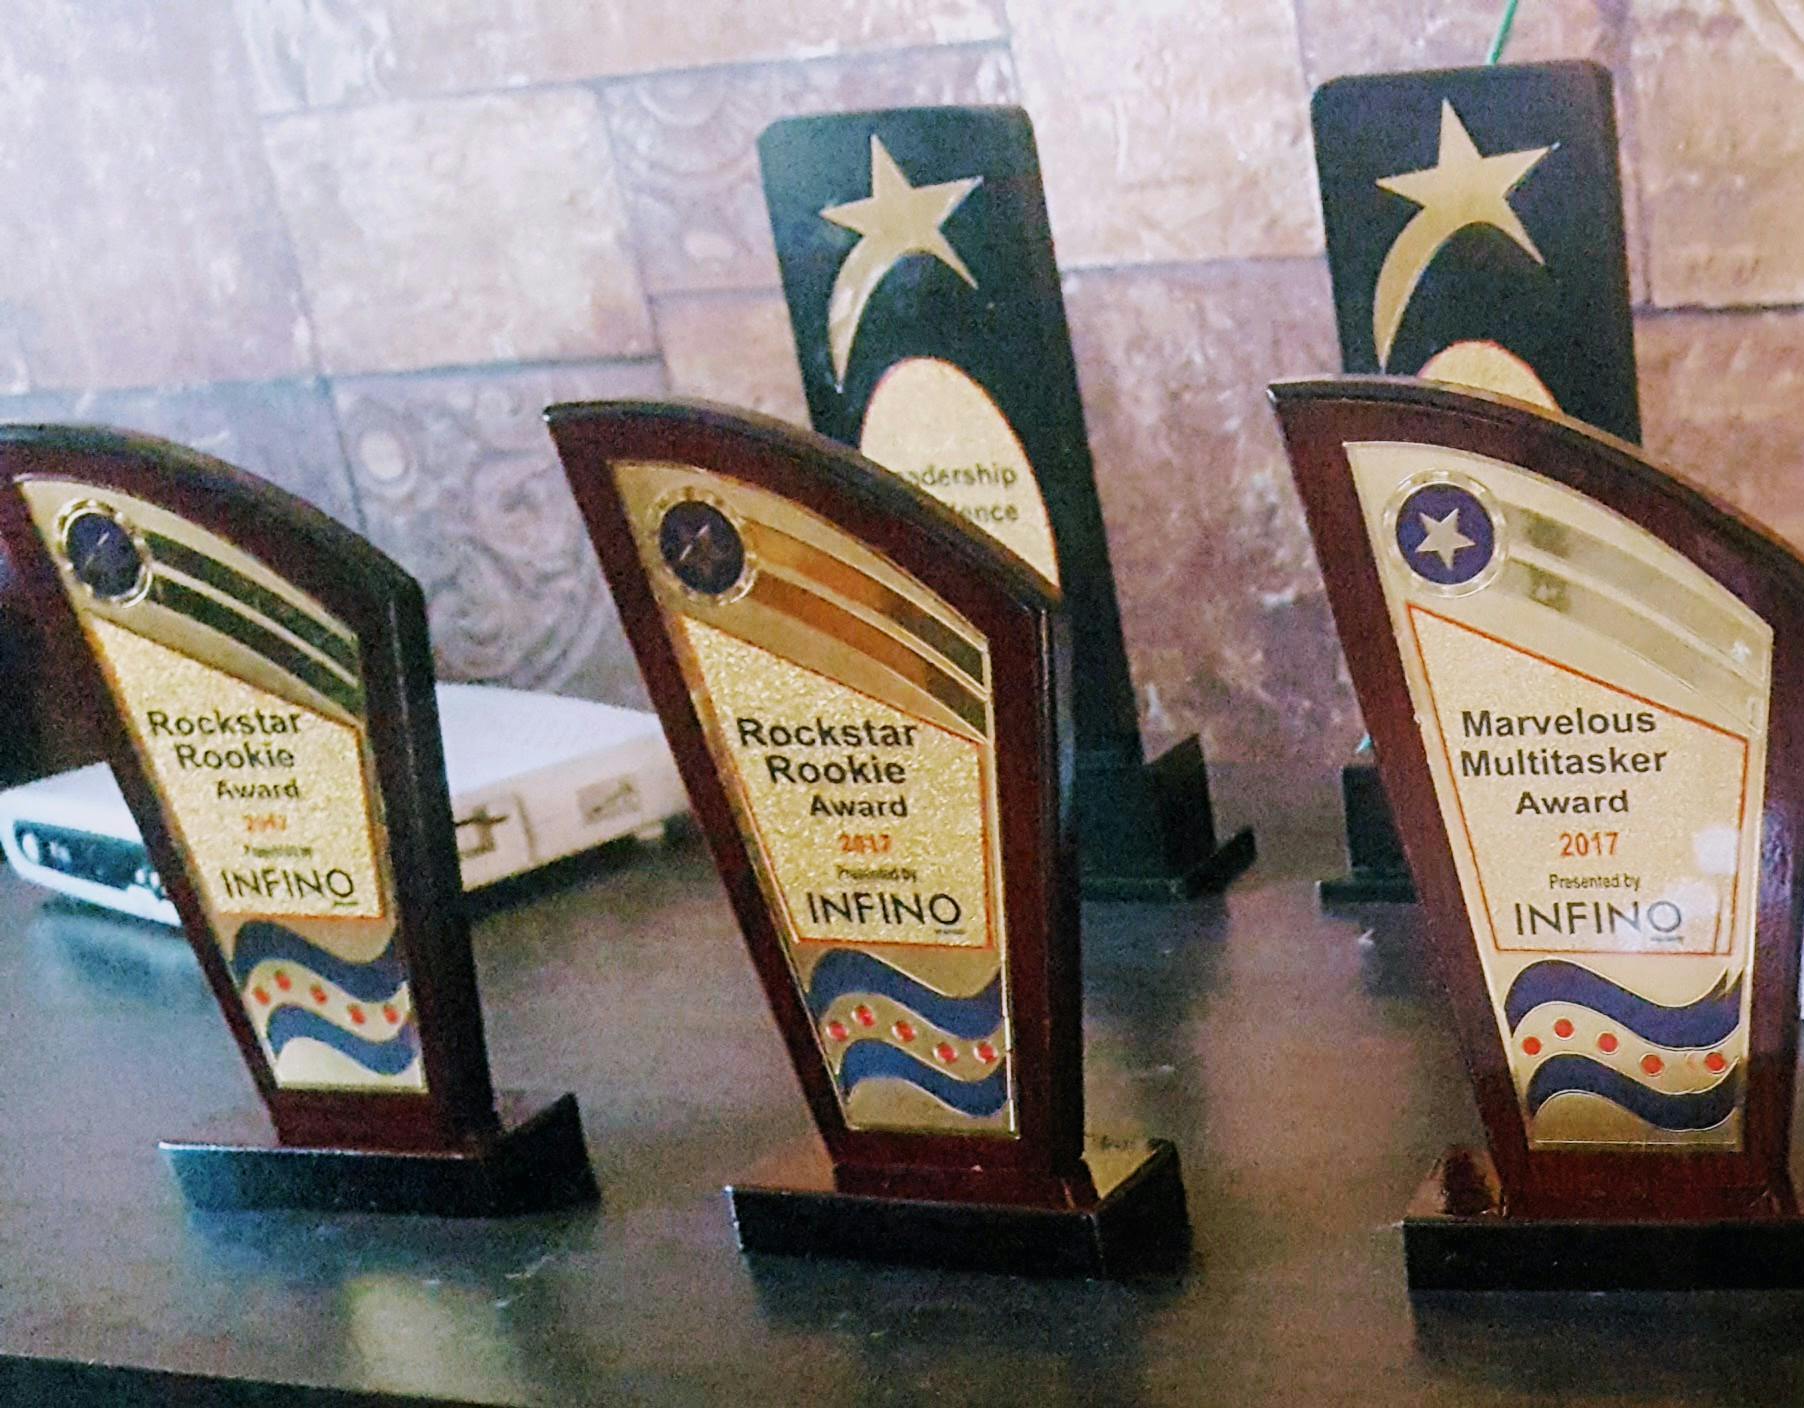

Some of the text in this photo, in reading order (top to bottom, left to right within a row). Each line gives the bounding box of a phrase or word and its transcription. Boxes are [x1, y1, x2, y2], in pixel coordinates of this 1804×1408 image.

[147, 708, 300, 736] Rockstar
[736, 717, 917, 748] Rockstar
[1461, 707, 1657, 738] Marvelous
[174, 741, 295, 769] Rookie
[1461, 747, 1668, 778] Multitasker
[766, 754, 907, 785] Rookie
[216, 777, 300, 800] Award
[1515, 789, 1629, 815] Award
[809, 794, 908, 818] Award
[838, 834, 892, 855] 2017
[1559, 832, 1620, 857] 2017
[221, 868, 355, 899] INFINO
[1549, 872, 1641, 891] Presented by
[806, 892, 961, 926] INFINO
[1515, 900, 1682, 935] INFINO
